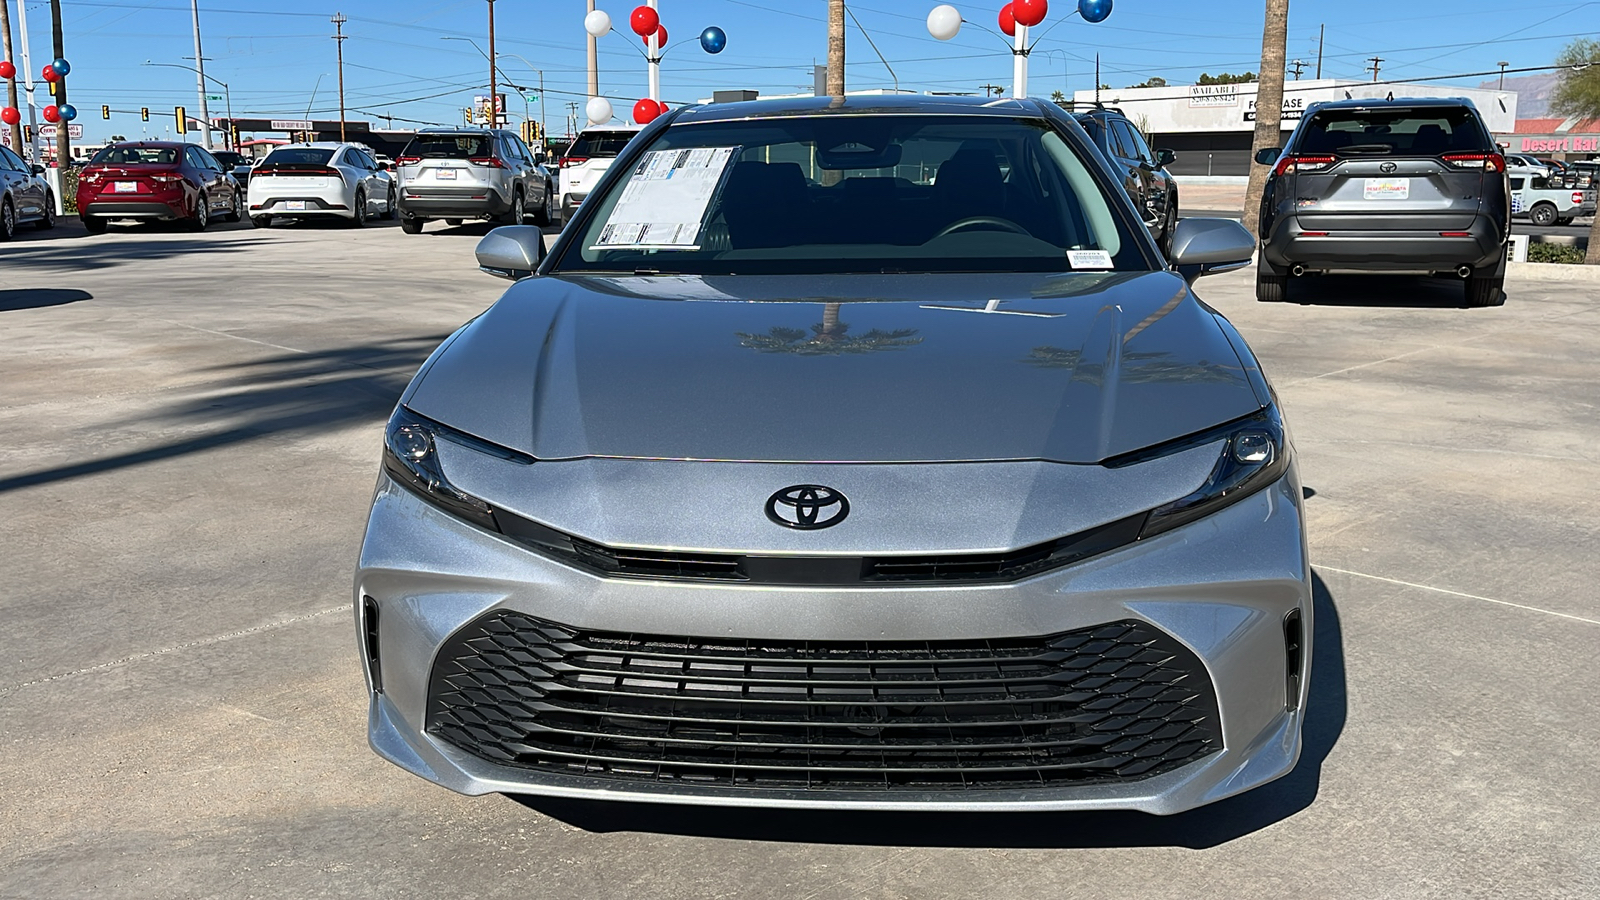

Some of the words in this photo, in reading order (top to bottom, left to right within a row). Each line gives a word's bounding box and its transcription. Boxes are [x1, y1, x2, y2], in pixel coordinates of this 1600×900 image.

[1191, 86, 1238, 95] AVAILABLE
[1283, 98, 1303, 108] ASE
[1521, 137, 1569, 152] Desert
[1572, 137, 1598, 152] Rat
